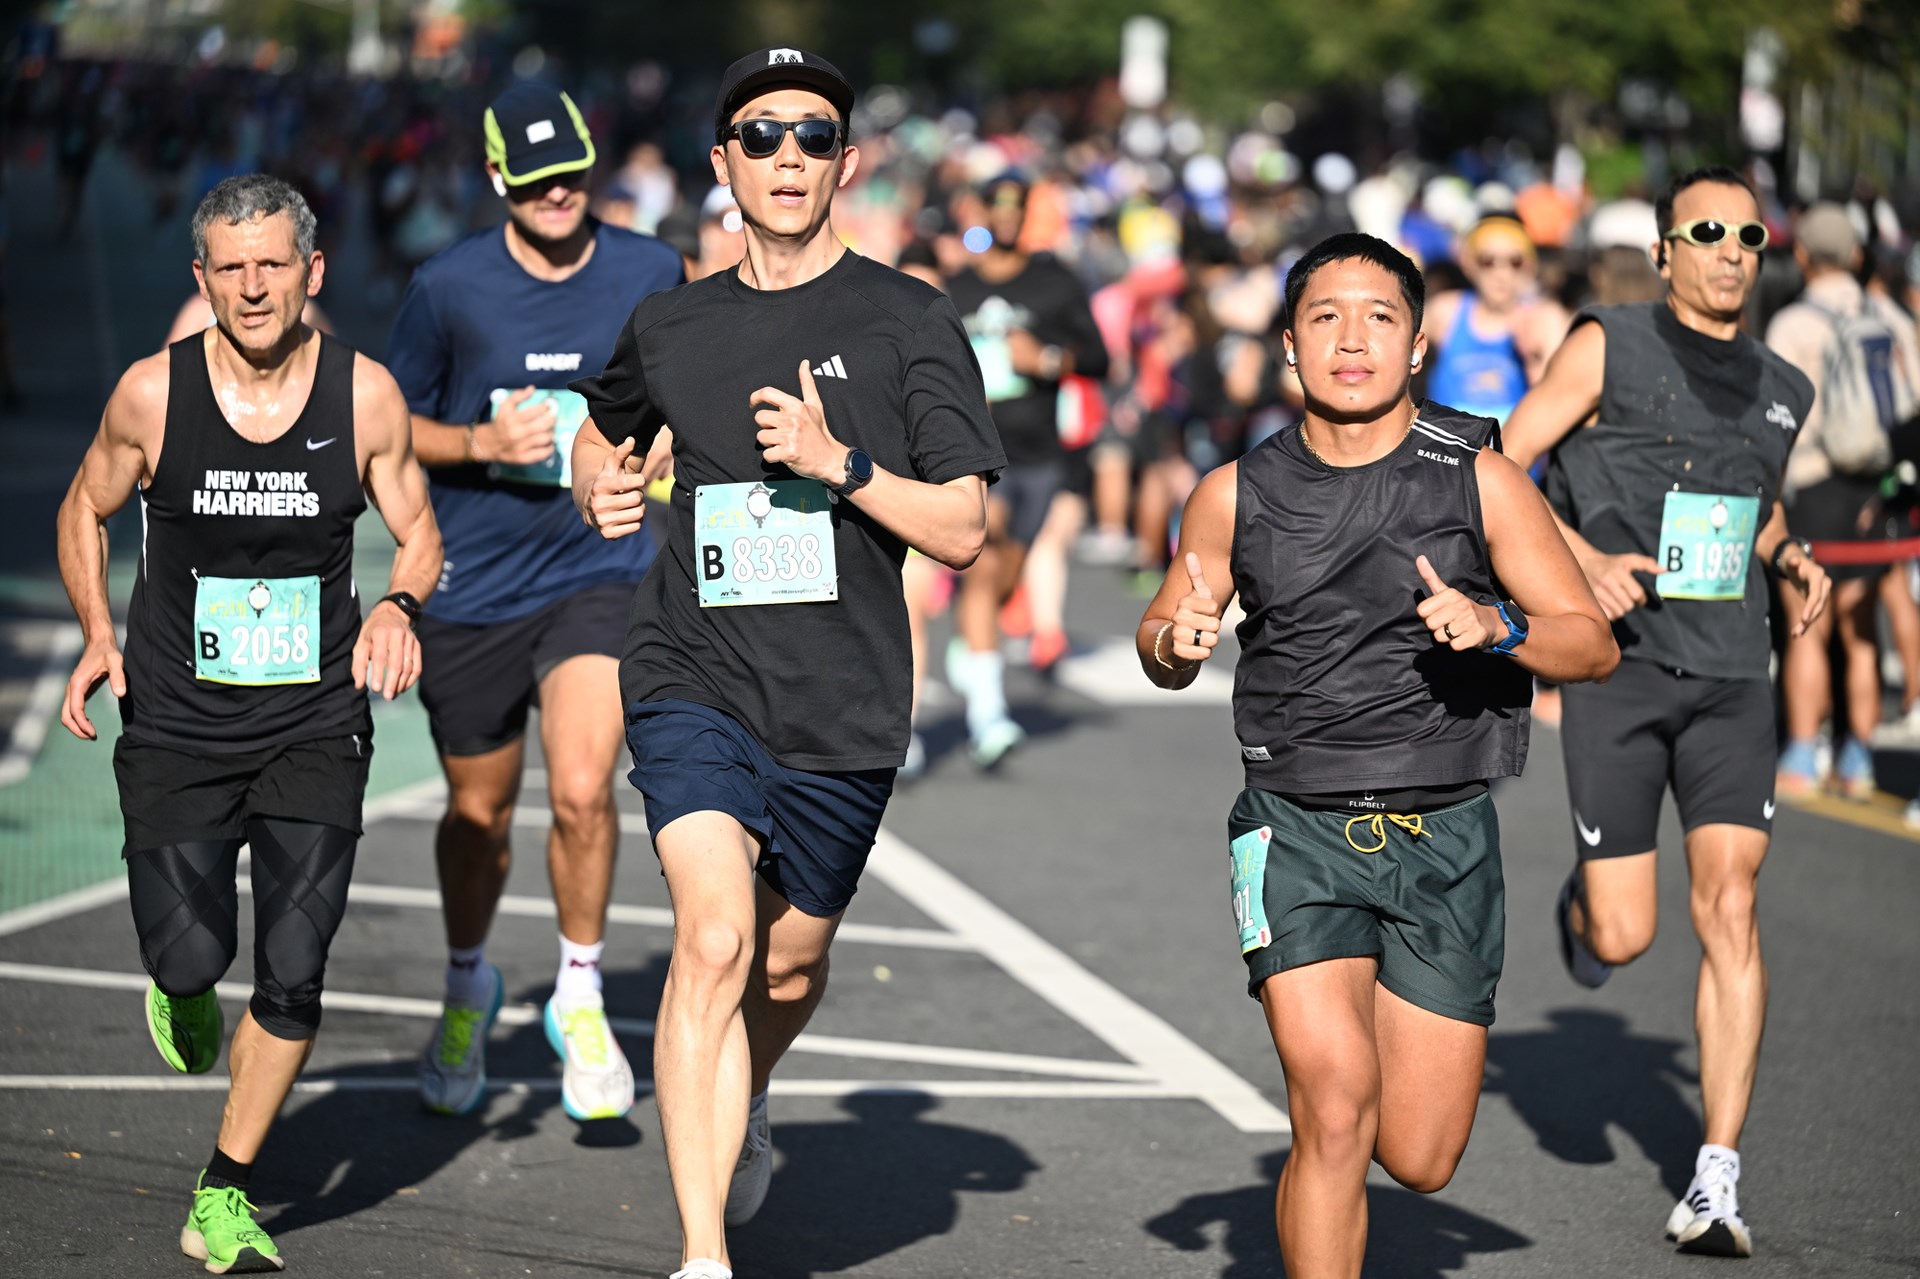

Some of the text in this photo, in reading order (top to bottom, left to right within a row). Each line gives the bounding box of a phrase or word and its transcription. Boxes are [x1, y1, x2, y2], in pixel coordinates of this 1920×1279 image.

[1417, 449, 1460, 466] BAKLINE
[205, 470, 308, 491] NEW YORK
[193, 490, 320, 517] HARRIERS
[703, 545, 724, 581] B
[732, 533, 822, 583] 8338
[1667, 541, 1745, 580] B 1935
[200, 623, 310, 666] B 2058
[1349, 800, 1386, 809] FLIPBELT
[1233, 882, 1255, 936] 91
